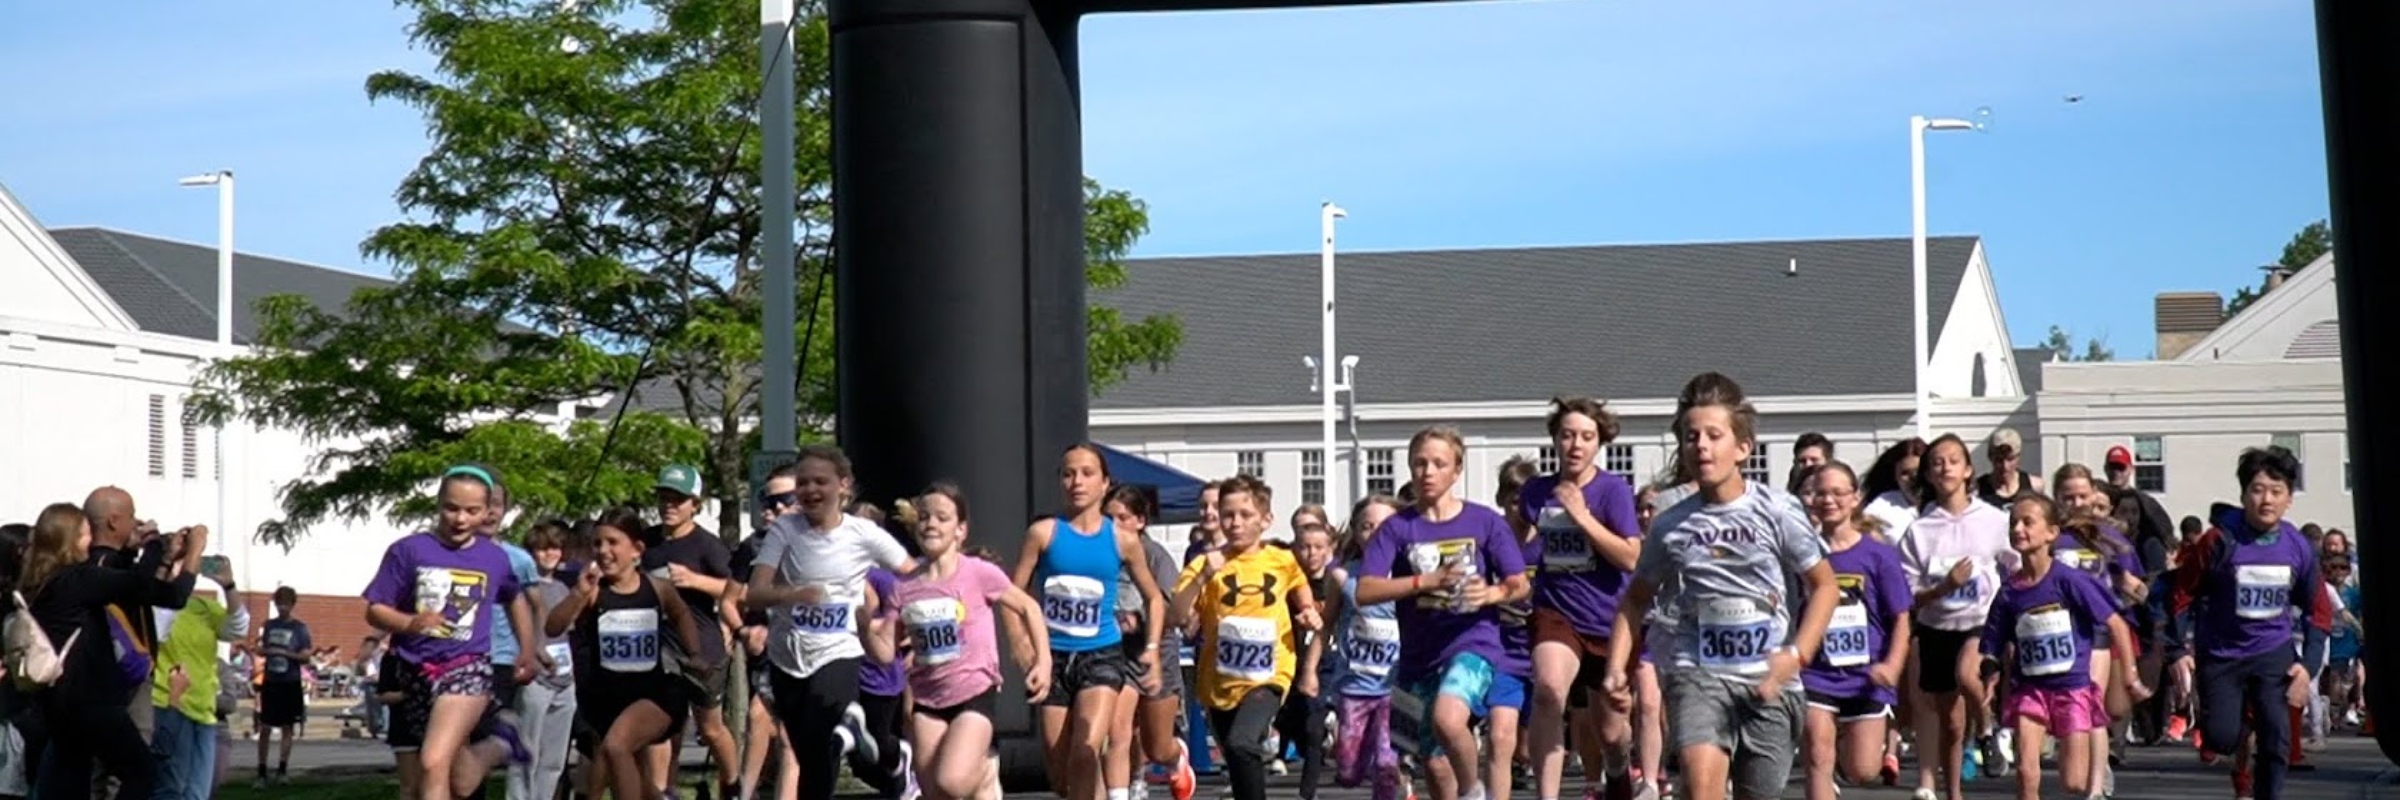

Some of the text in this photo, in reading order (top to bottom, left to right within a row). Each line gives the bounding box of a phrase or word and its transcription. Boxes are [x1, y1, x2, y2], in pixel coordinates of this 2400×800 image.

[1687, 526, 1757, 549] AVON
[792, 604, 848, 629] 3652
[1046, 596, 1099, 625] 3581
[602, 634, 655, 659] 3518
[1219, 640, 1273, 668] 3723
[1348, 639, 1398, 664] 3762
[1702, 627, 1769, 658] 3632
[2021, 635, 2073, 664] 3515
